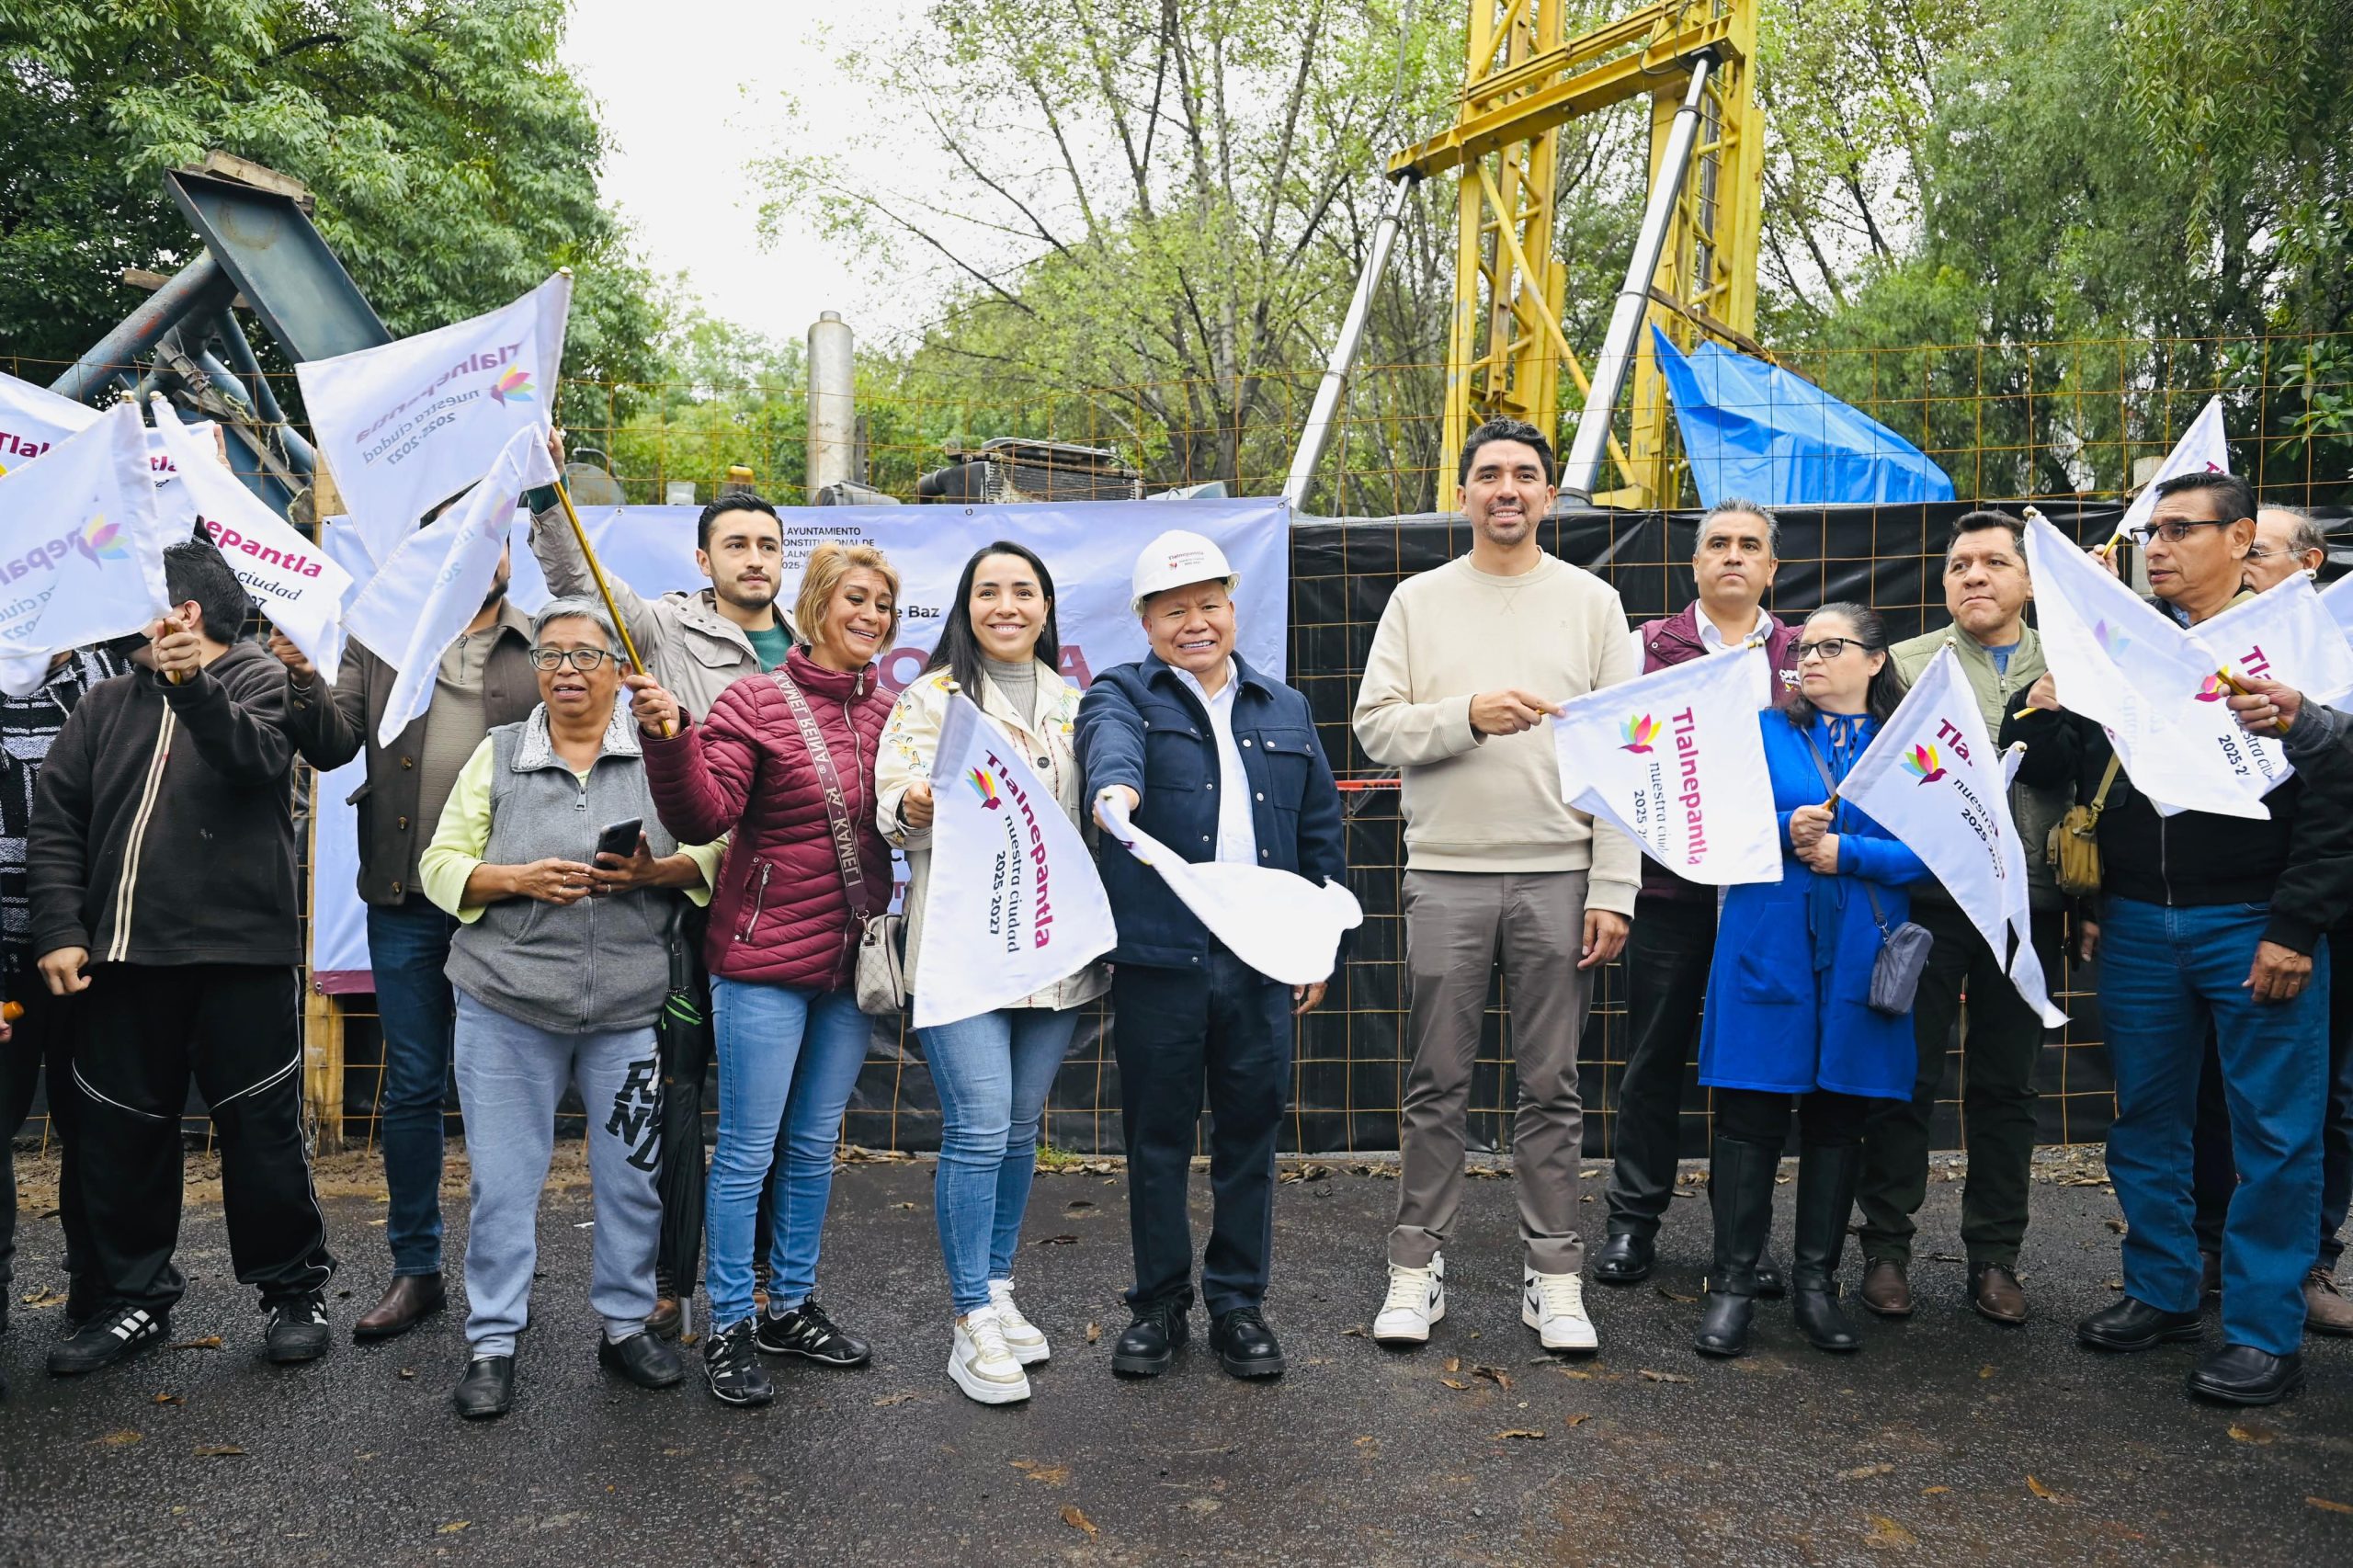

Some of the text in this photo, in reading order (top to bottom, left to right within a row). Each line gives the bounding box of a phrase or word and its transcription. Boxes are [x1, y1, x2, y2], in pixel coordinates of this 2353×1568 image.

[200, 516, 323, 577] epantla
[787, 527, 861, 536] AYUNTAMIENTO
[862, 539, 875, 547] DE
[237, 571, 303, 600] ciudad
[908, 606, 940, 619] Baz
[1649, 762, 1666, 822] nuestra
[1672, 706, 1708, 865] Tlalnepantla
[985, 749, 1053, 949] Tlalnepantla
[1005, 814, 1022, 953] nuestra ciudad
